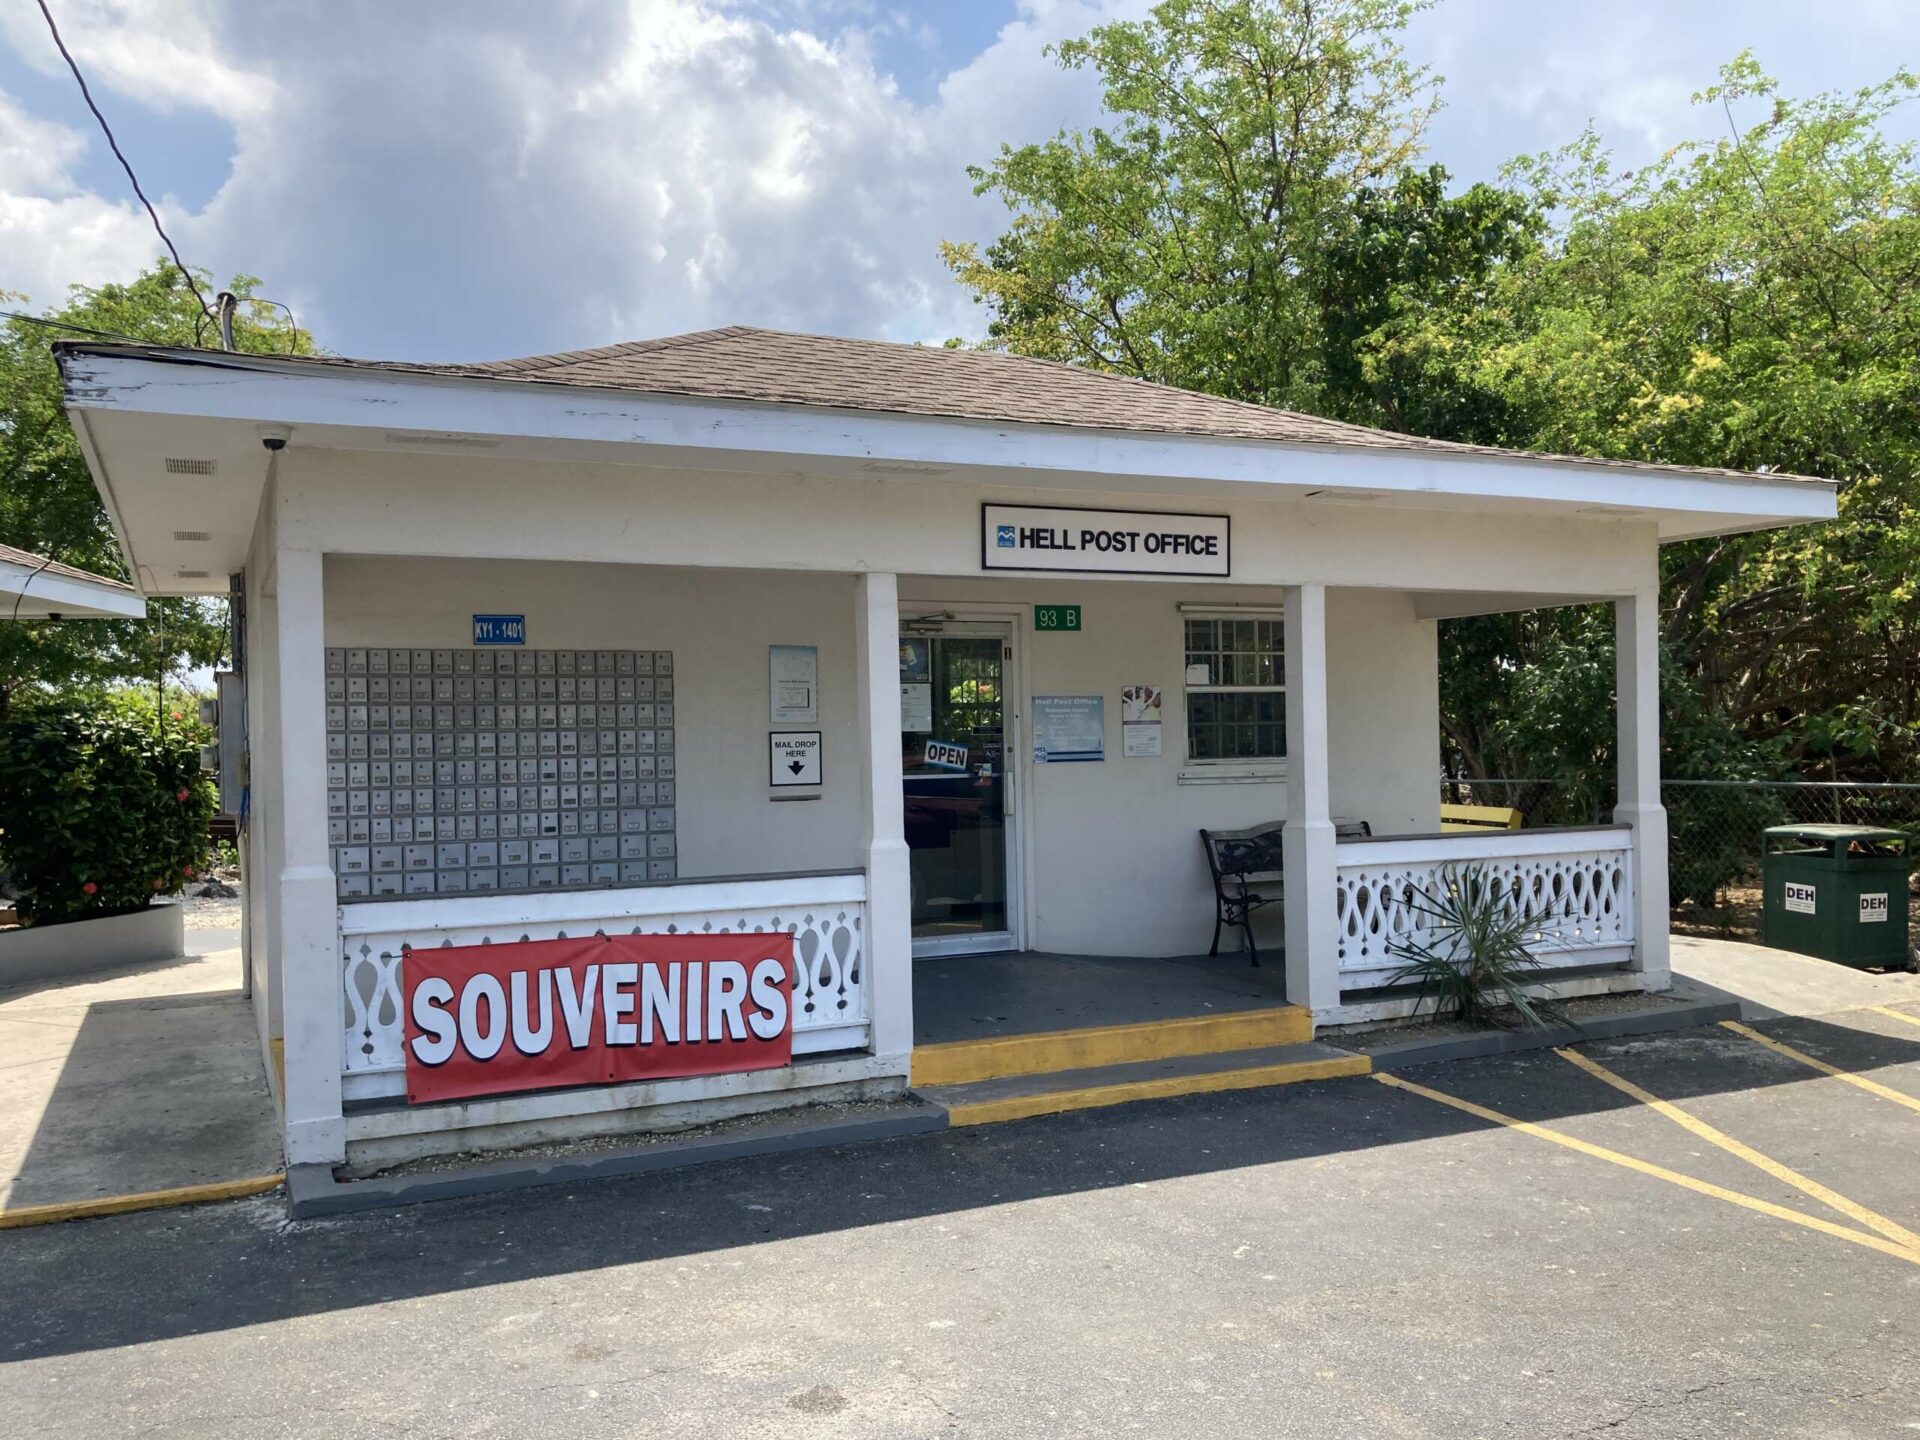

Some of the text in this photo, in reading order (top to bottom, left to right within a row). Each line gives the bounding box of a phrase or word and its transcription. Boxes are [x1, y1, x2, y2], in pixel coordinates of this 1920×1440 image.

[1019, 527, 1218, 556] HELL POST OFFICE
[1039, 609, 1077, 627] 93 B
[502, 622, 522, 638] 1401
[775, 740, 817, 749] MAIL DROP
[928, 744, 966, 767] OPEN
[1786, 886, 1814, 902] DEH
[1861, 897, 1887, 910] DEH
[409, 957, 789, 1068] SOUVENIRS
